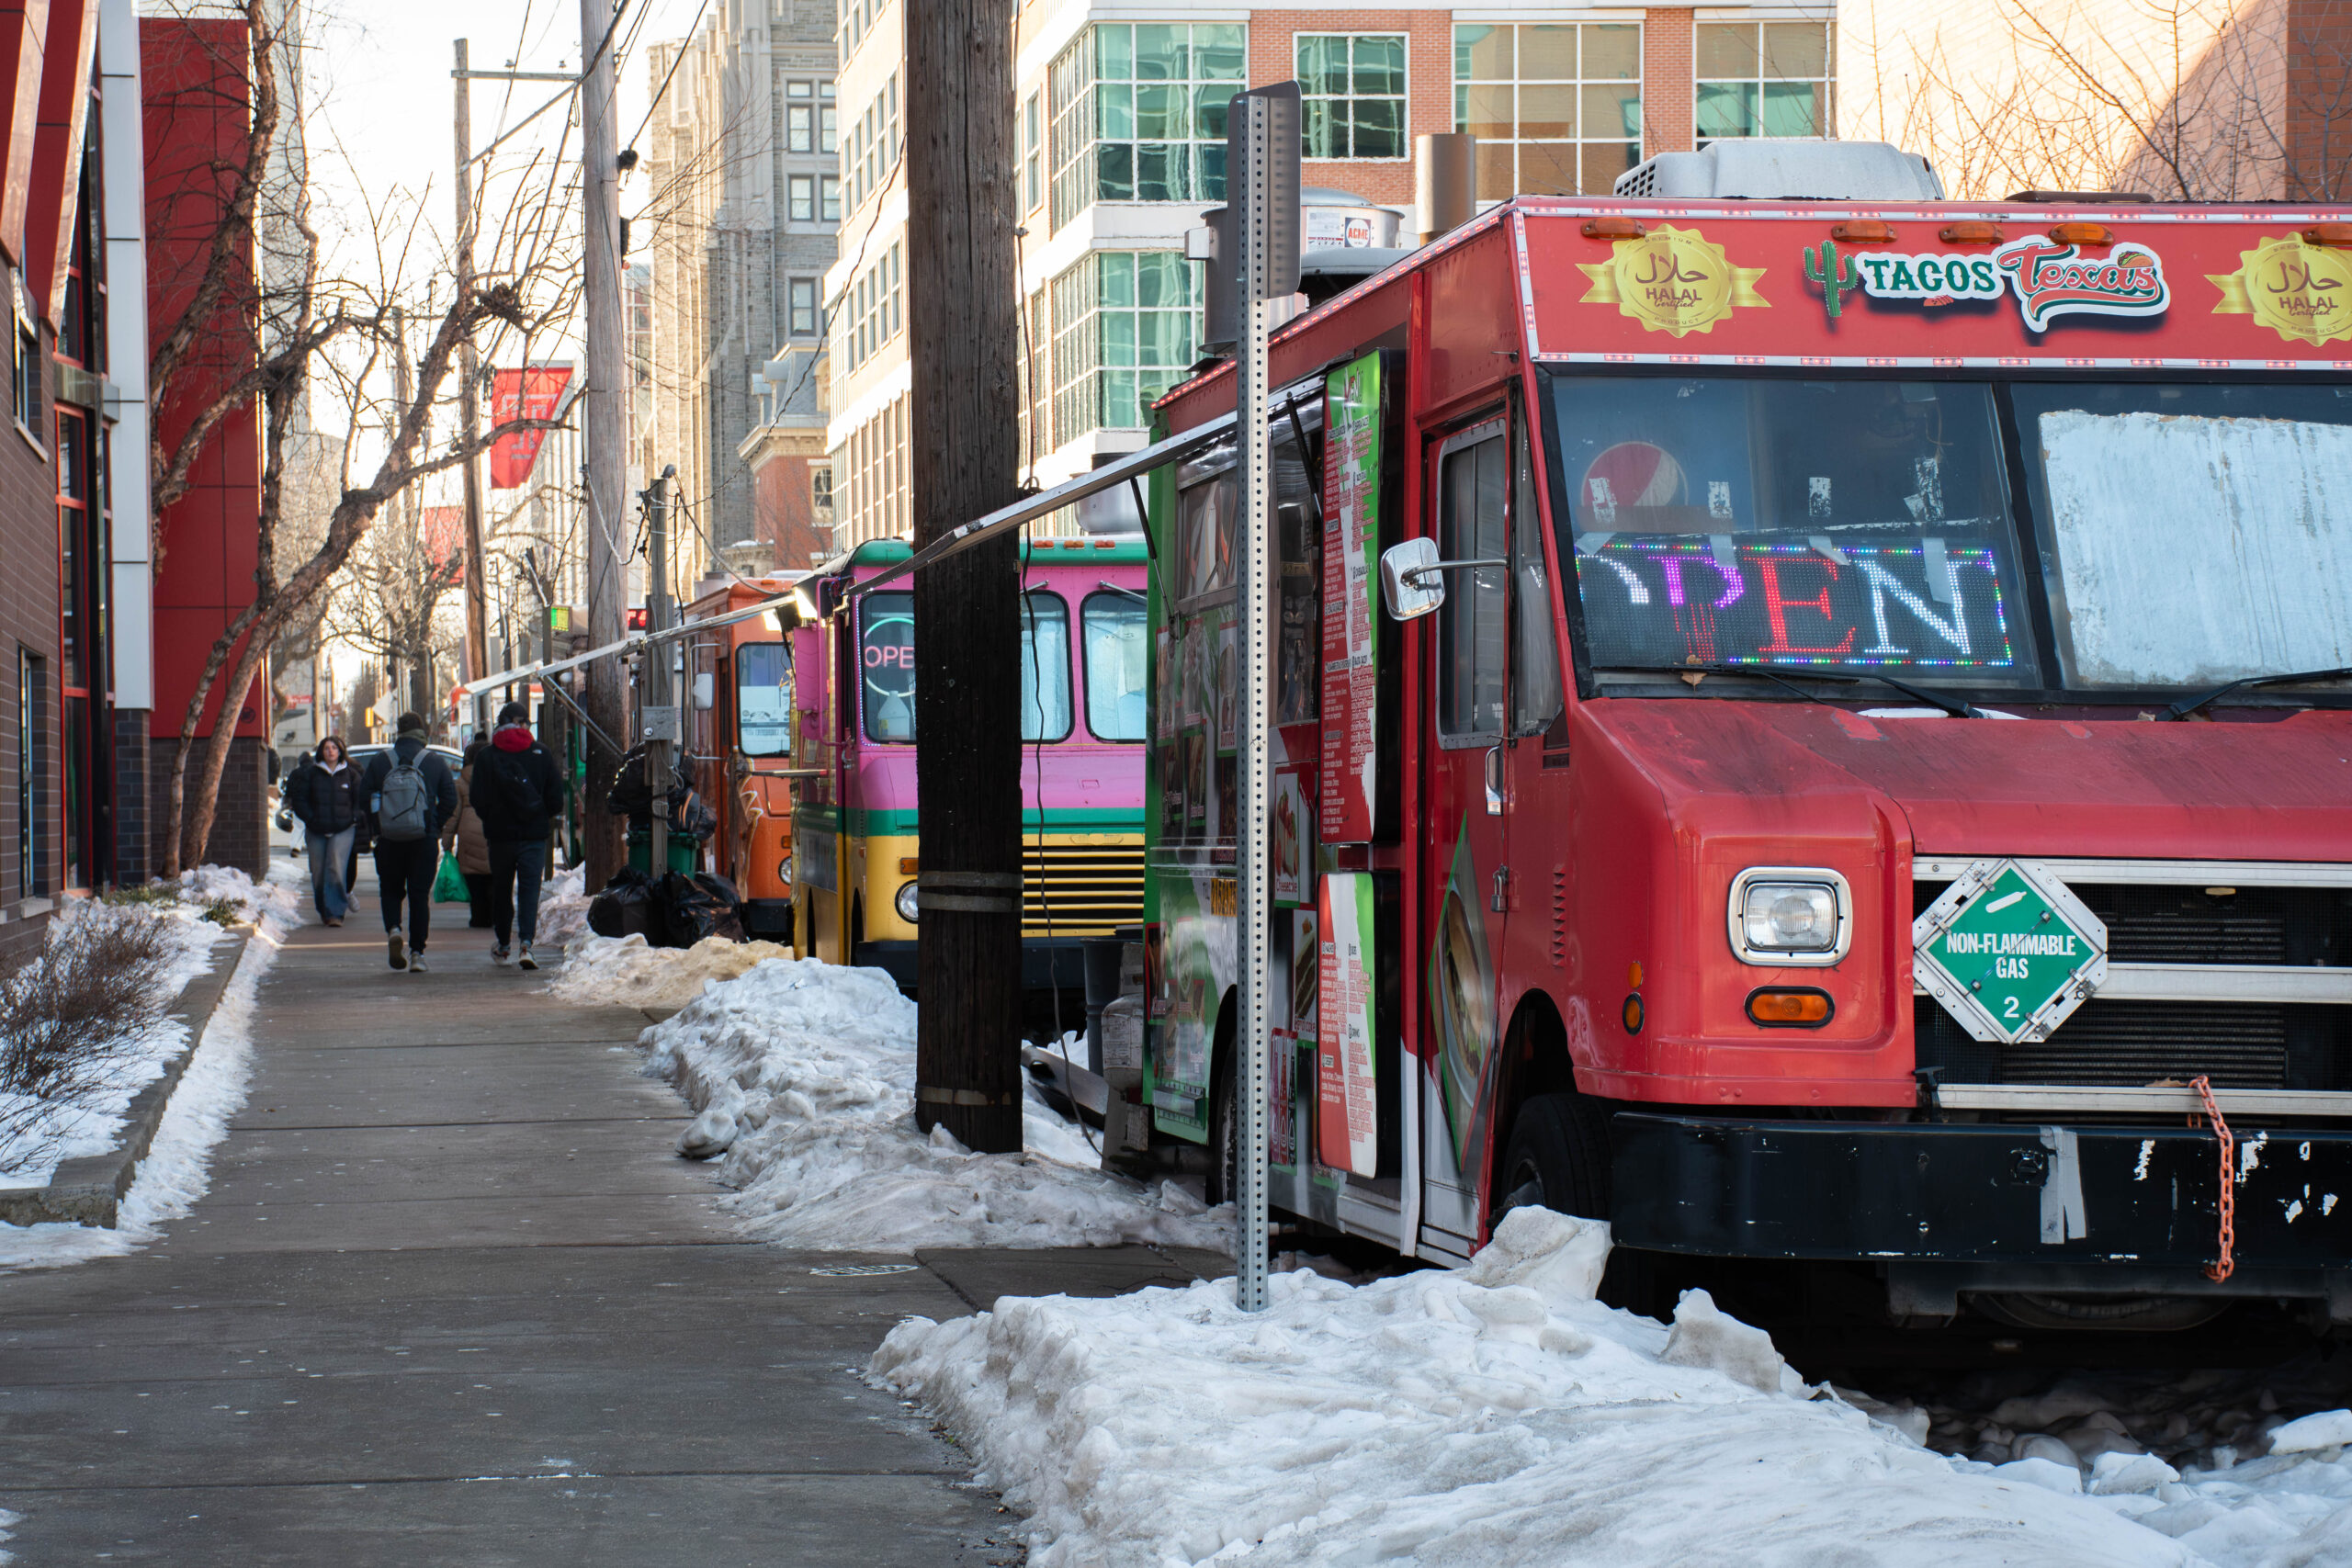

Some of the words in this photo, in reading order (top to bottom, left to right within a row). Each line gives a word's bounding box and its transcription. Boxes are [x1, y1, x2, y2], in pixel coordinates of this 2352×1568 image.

[1348, 228, 1368, 241] ACME
[1635, 252, 1709, 284] حلال
[2267, 261, 2344, 293] حلال
[1863, 258, 1996, 293] TACOS
[1997, 242, 2161, 318] Texas
[1645, 287, 1702, 301] HALAL
[1654, 299, 1696, 310] Certified
[2278, 296, 2339, 310] HALAL
[1654, 316, 1700, 326] PRODUCT
[2289, 308, 2332, 319] Certified
[865, 646, 915, 669] OPE
[1946, 932, 2076, 956] NON-FLAMMABLE
[1996, 958, 2029, 979] GAS
[2004, 997, 2019, 1018] 2
